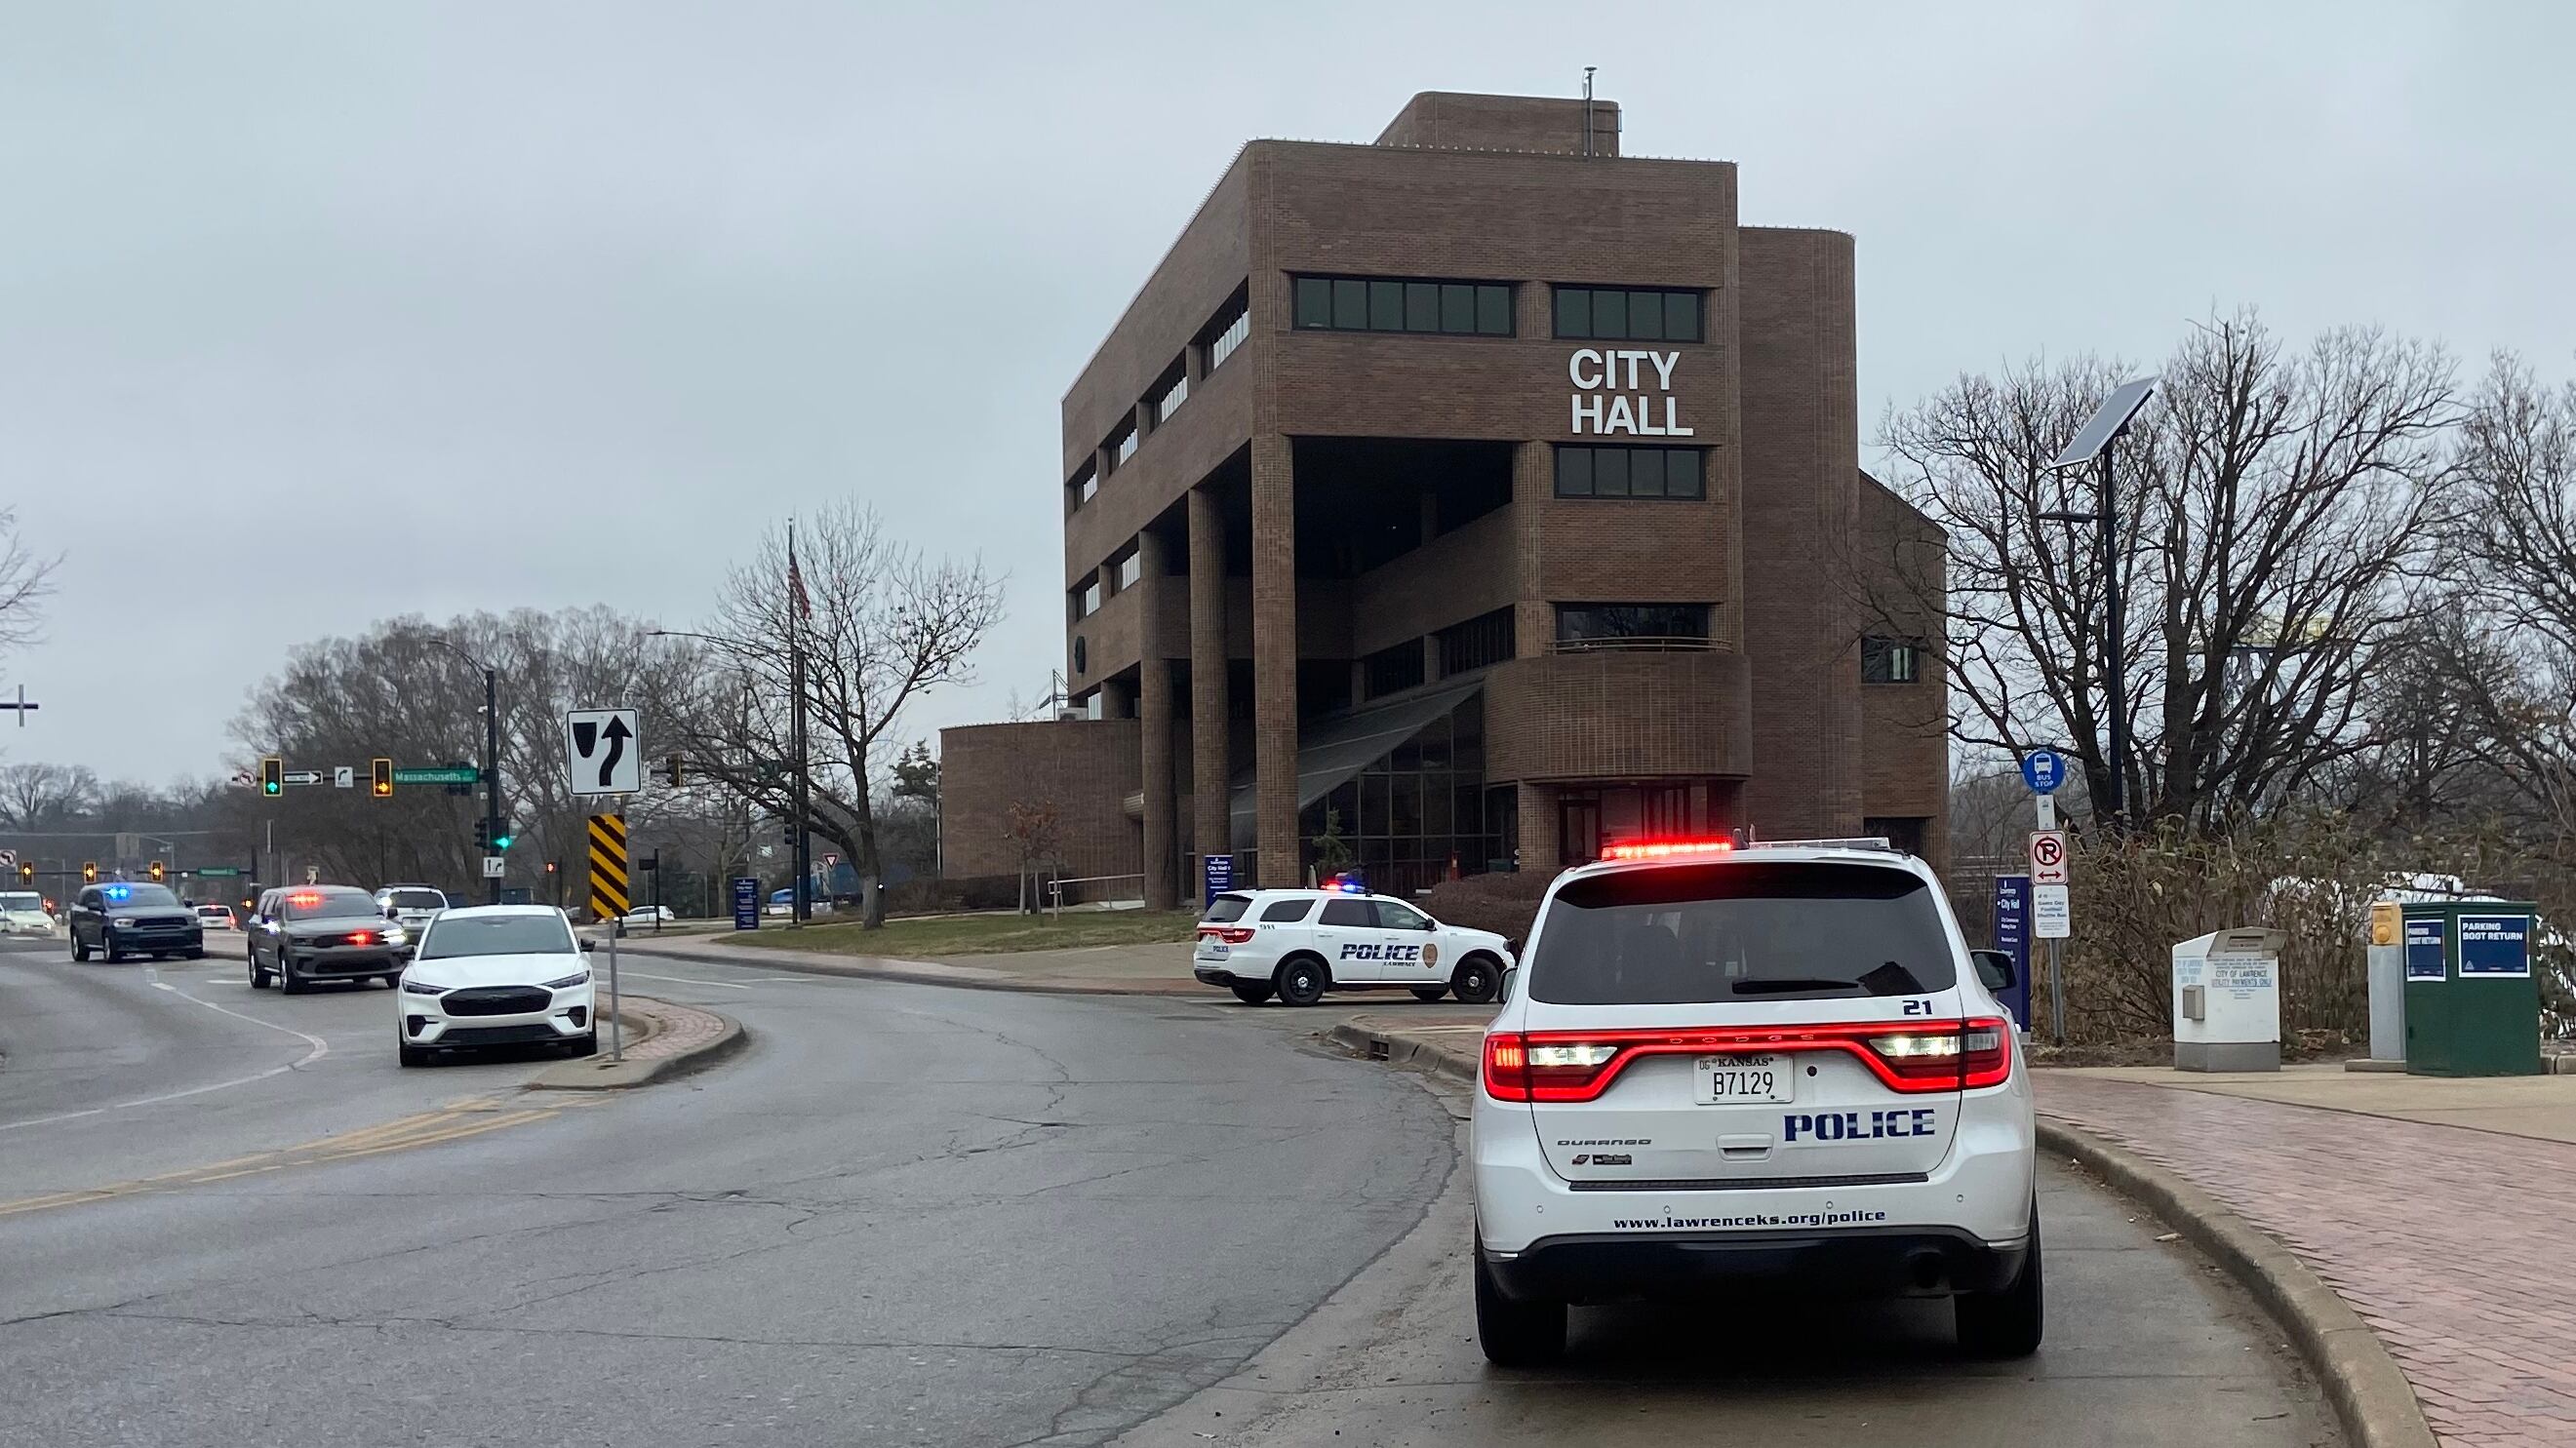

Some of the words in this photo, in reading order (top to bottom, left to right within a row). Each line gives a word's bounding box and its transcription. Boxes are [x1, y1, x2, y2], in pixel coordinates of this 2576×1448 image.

[1568, 348, 1681, 390] CITY
[1571, 394, 1694, 436] HALL
[395, 771, 461, 781] Massachusetts
[2462, 922, 2501, 931] PARKING
[2462, 931, 2485, 941] BOOT
[2487, 931, 2523, 941] RETURN
[1339, 943, 1420, 961] POLICE
[2215, 969, 2229, 978] CITY
[2230, 969, 2238, 978] OF
[2239, 969, 2268, 978] LAWRENCE
[1902, 999, 1933, 1016] 21
[1718, 1058, 1770, 1068] KANSAS
[1714, 1071, 1774, 1095] B7129
[1784, 1109, 1935, 1142] POLICE
[1613, 1210, 1886, 1230] www.lawrenceks.org/police
